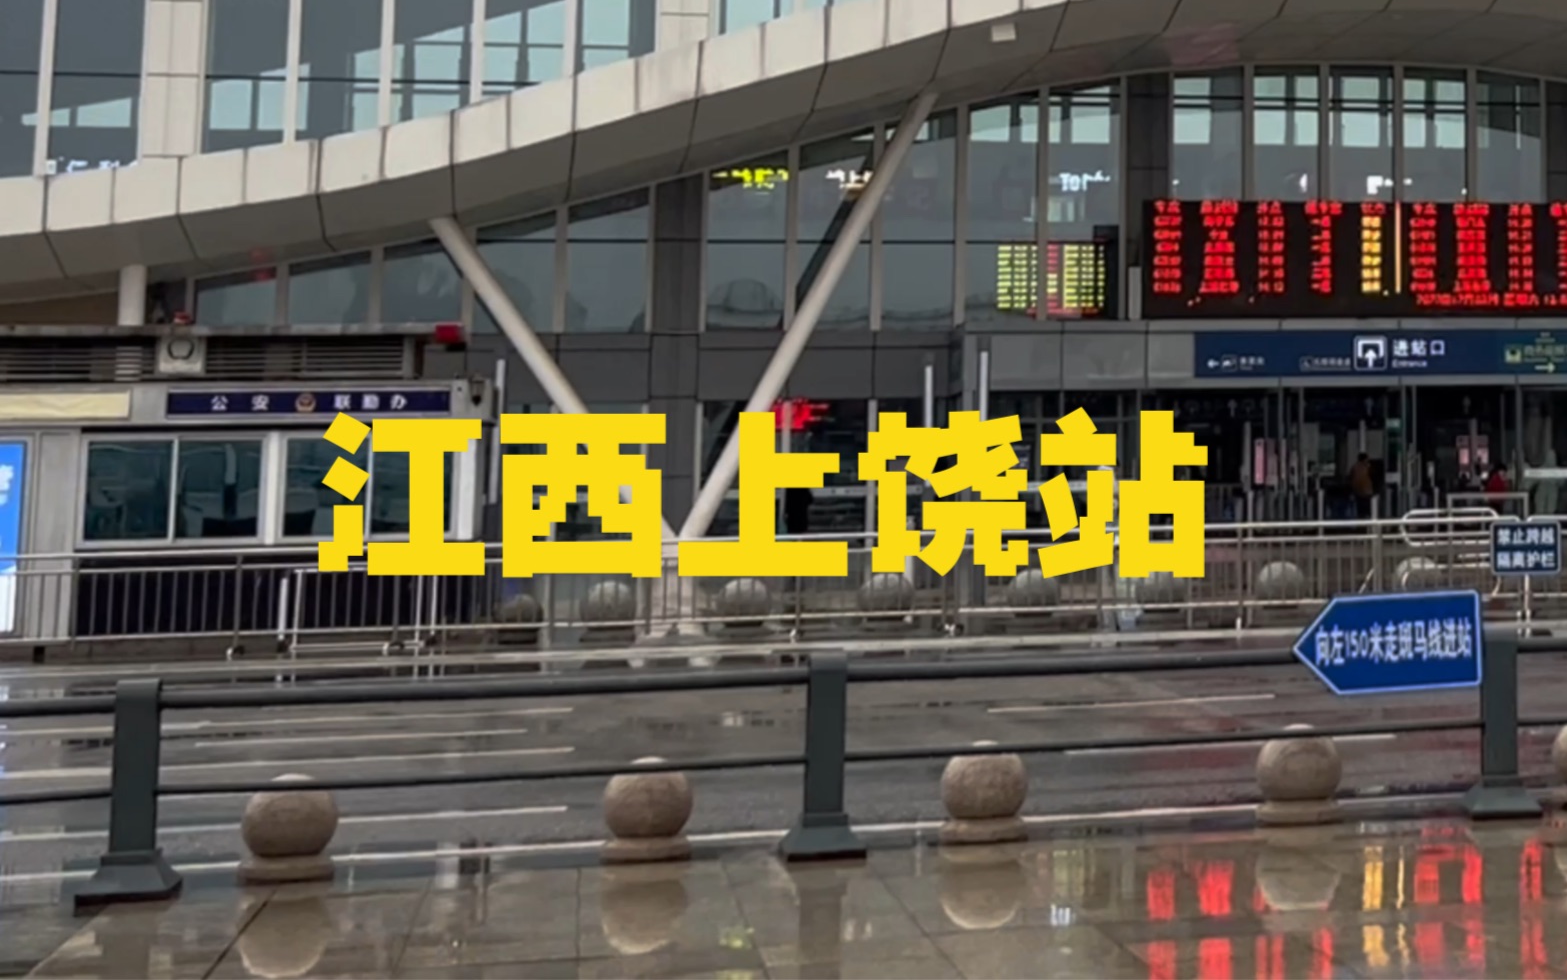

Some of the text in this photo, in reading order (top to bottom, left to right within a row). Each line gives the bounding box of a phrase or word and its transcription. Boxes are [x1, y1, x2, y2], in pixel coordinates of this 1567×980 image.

[1392, 338, 1445, 357] 进站口
[211, 395, 270, 411] 公安
[1497, 526, 1555, 546] 禁止跨越
[1497, 550, 1556, 569] 隔离护栏
